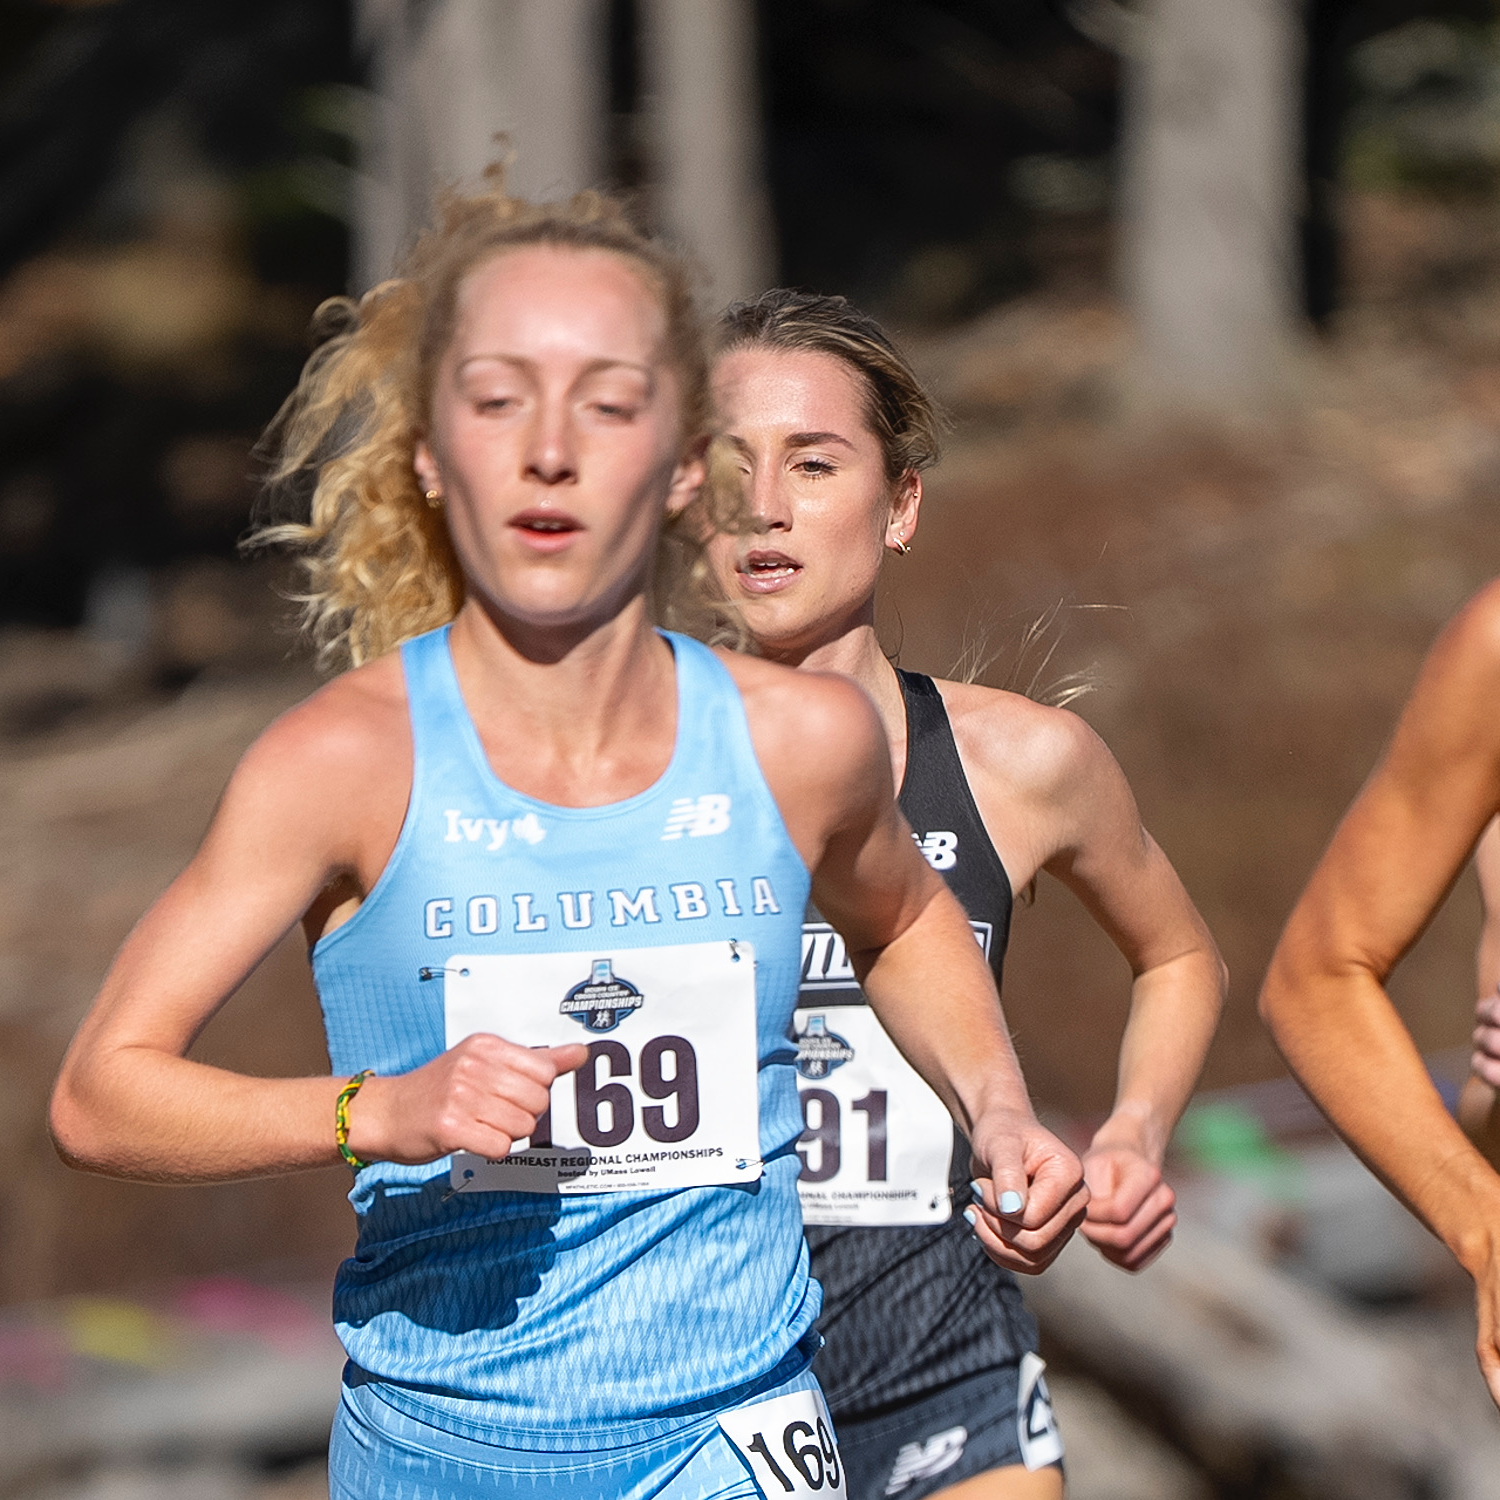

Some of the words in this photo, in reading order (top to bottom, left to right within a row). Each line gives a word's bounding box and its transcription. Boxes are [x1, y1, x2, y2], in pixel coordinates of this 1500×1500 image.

[443, 809, 510, 851] Ivy
[660, 793, 731, 841] NB
[424, 876, 781, 939] COLUMBIA
[560, 995, 642, 1013] CHAMPIONSHIPS
[560, 1155, 622, 1167] REGIONAL
[625, 1148, 724, 1164] CHAMPIONSHIPS
[797, 1088, 888, 1183] 91
[557, 1169, 586, 1177] hosted
[589, 1169, 599, 1177] by
[601, 1168, 628, 1176] UMass
[630, 1166, 656, 1174] Lowell
[747, 1415, 841, 1493] 169
